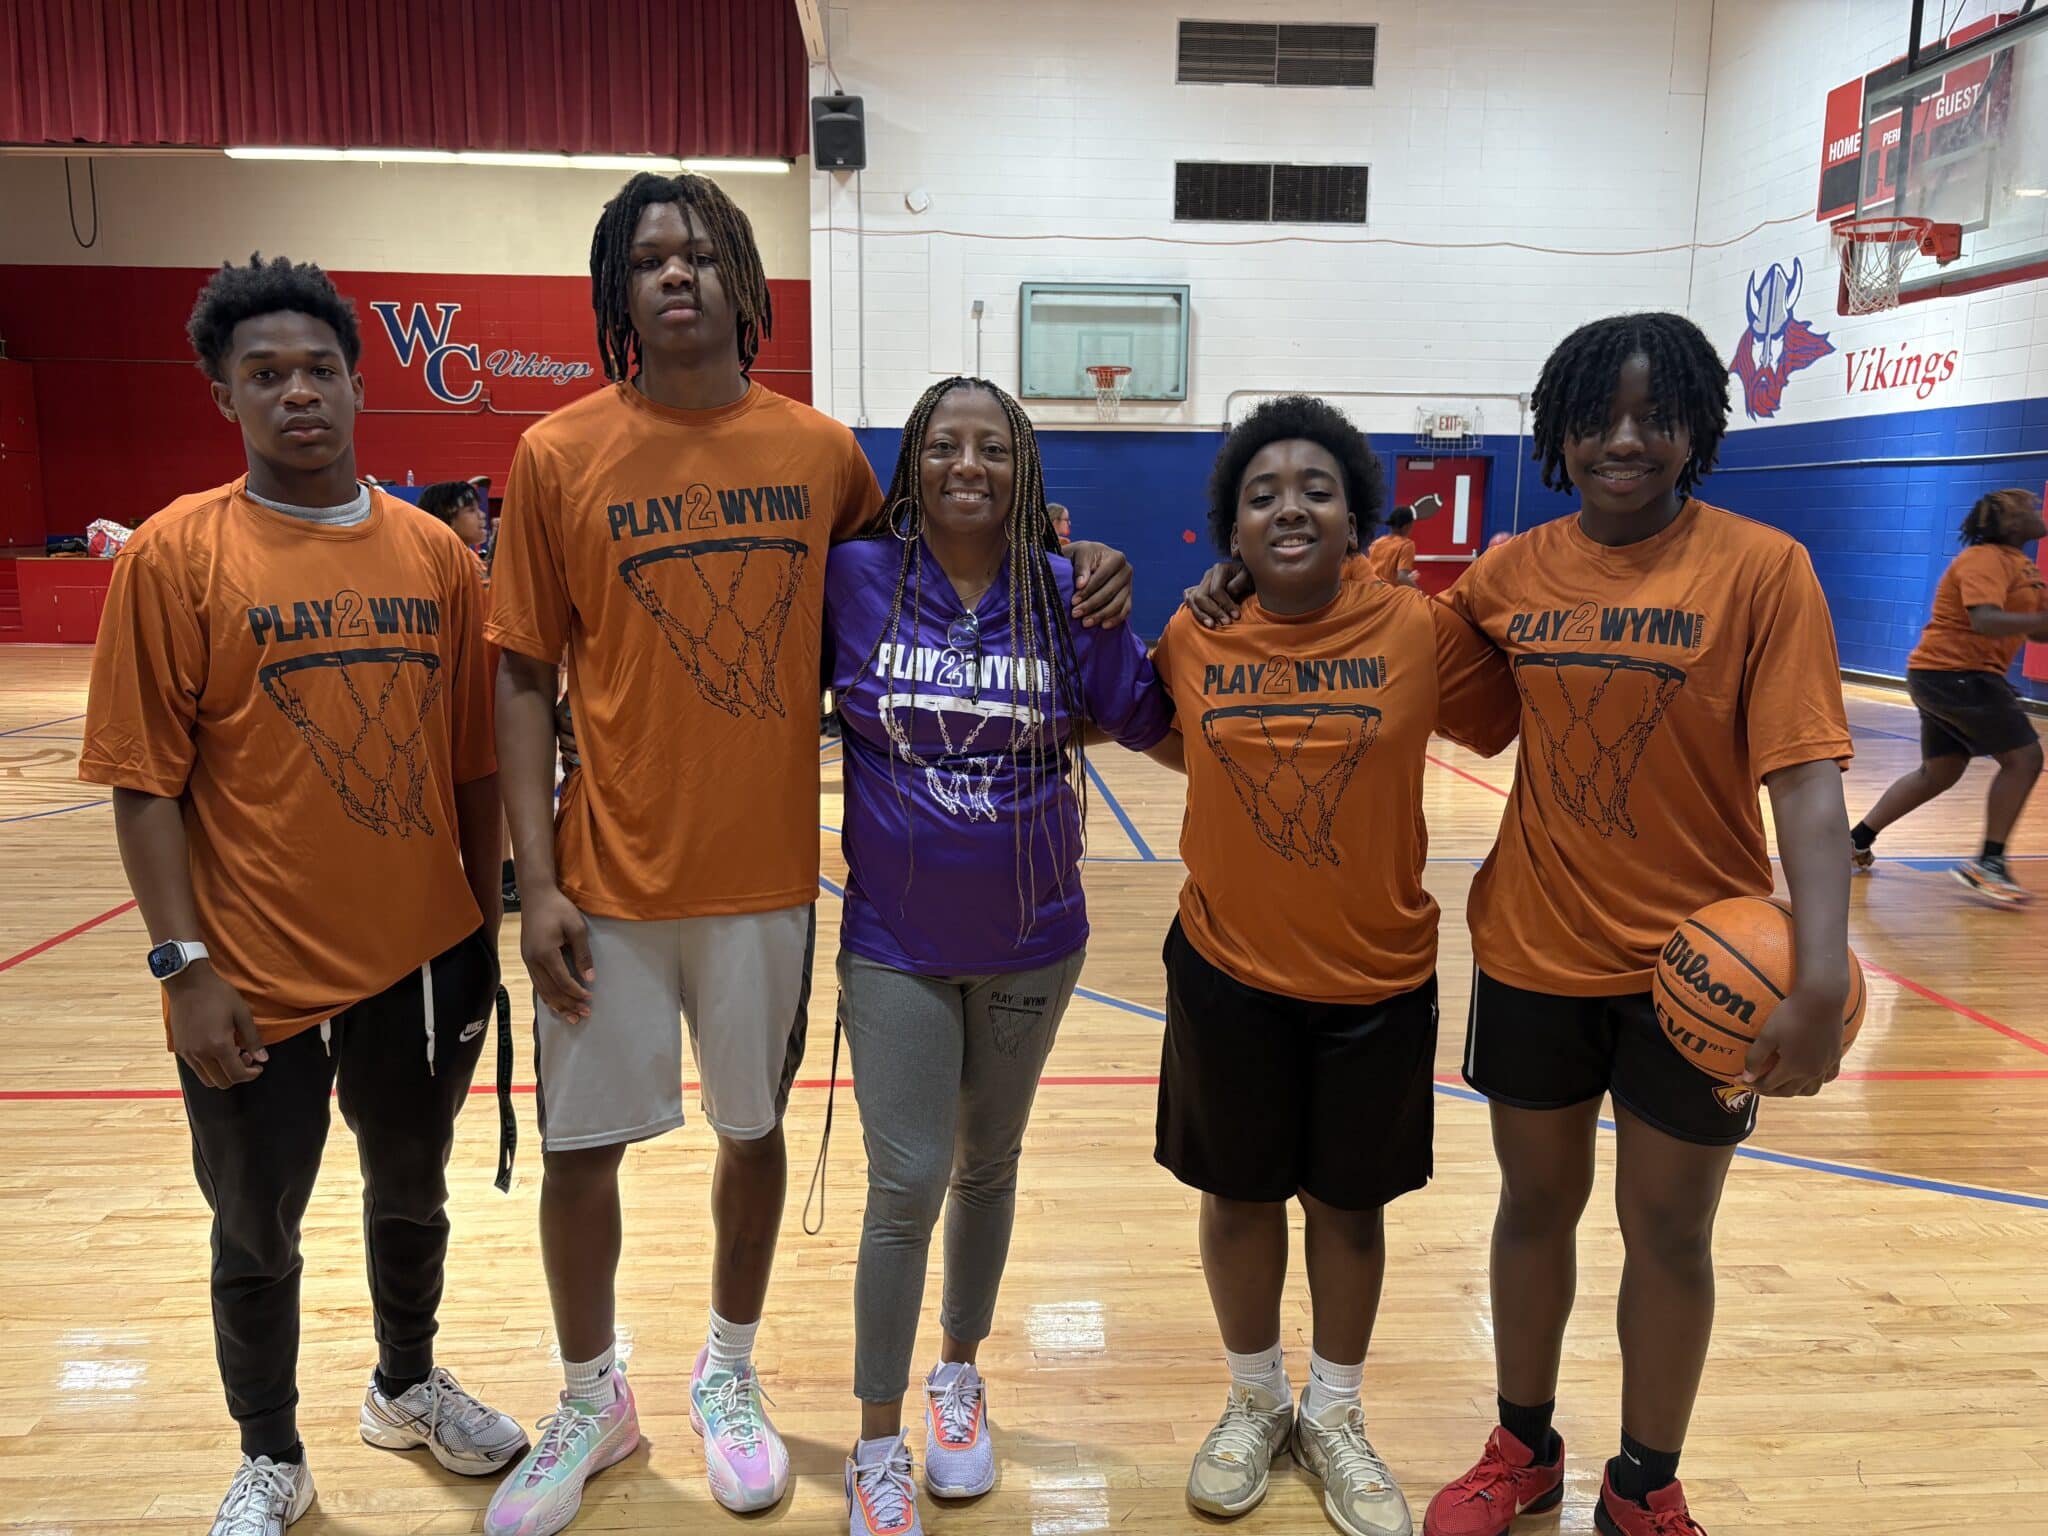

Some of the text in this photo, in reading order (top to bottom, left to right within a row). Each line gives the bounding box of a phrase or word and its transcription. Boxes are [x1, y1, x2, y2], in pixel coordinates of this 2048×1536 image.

[1935, 83, 1981, 120] GUEST
[1828, 132, 1862, 162] HOME
[1882, 128, 1901, 147] PERI
[486, 350, 594, 385] Vikings
[1845, 342, 1958, 400] Vikings
[1439, 416, 1457, 432] EXIT
[1663, 931, 1756, 1025] Wilson
